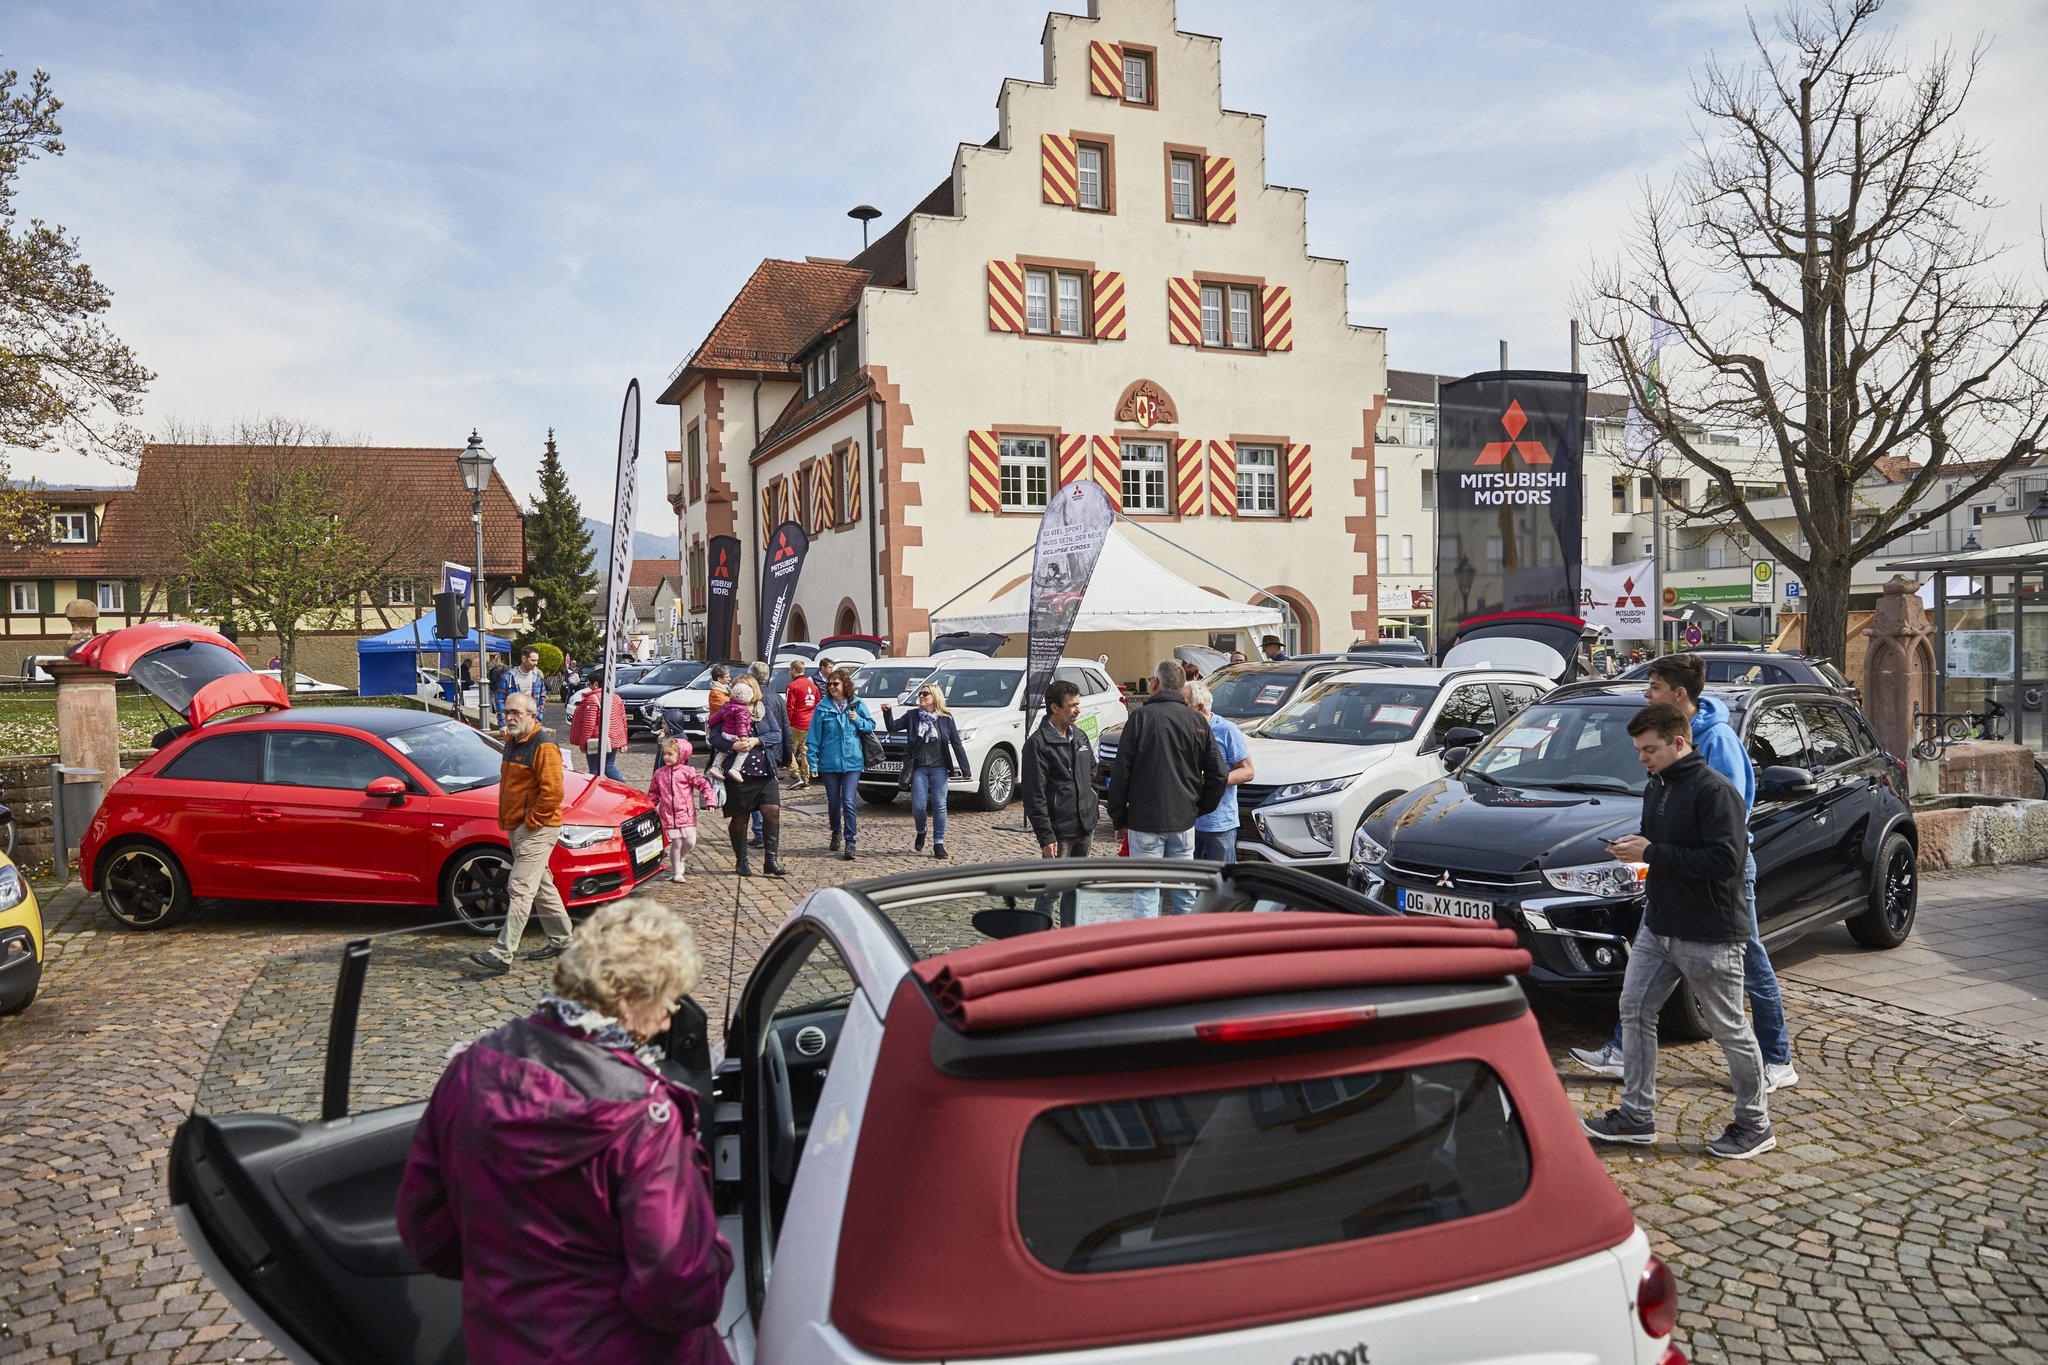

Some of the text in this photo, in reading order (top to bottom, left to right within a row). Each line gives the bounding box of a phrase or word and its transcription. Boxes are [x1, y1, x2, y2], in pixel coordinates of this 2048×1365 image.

[1460, 472, 1567, 488] MITSUBISHI
[1474, 490, 1551, 505] MOTORS
[1051, 528, 1063, 536] VIEL
[1065, 525, 1082, 533] SPORT
[1042, 531, 1103, 546] MUSS SEIN: DER NEUE
[1042, 543, 1091, 555] ECLIPSE CROSS
[771, 556, 798, 572] MITSUBISHI
[774, 565, 795, 578] MOTORS
[1406, 893, 1424, 910] OG
[1434, 896, 1451, 916] XX
[1454, 900, 1490, 920] 1018
